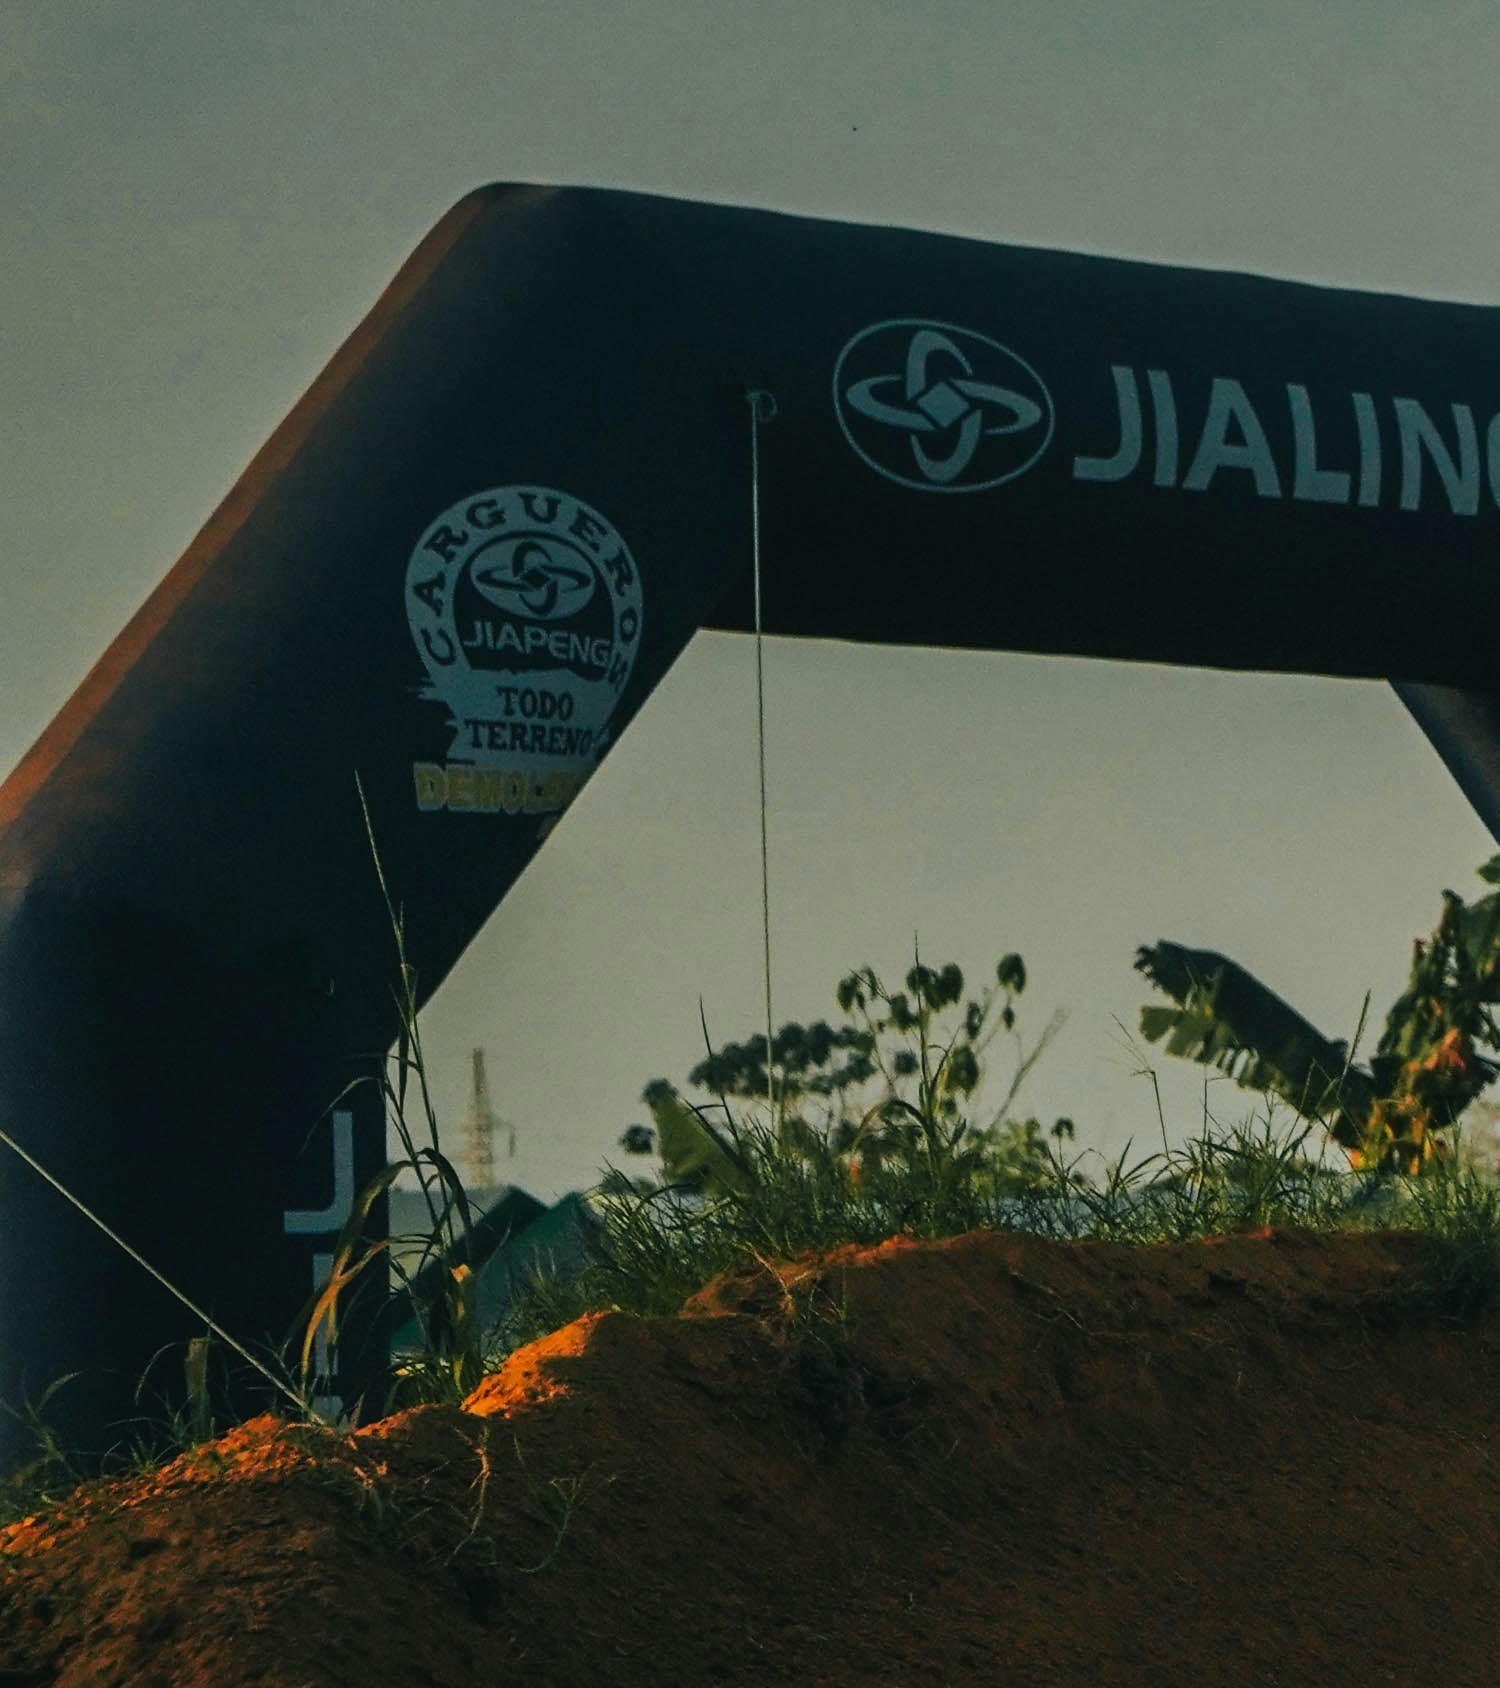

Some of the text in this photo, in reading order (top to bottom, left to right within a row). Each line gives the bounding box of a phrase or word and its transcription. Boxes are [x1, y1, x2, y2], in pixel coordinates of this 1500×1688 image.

[462, 619, 613, 668] JIAPENG
[497, 686, 574, 722] TODO
[465, 718, 596, 757] TERRENO
